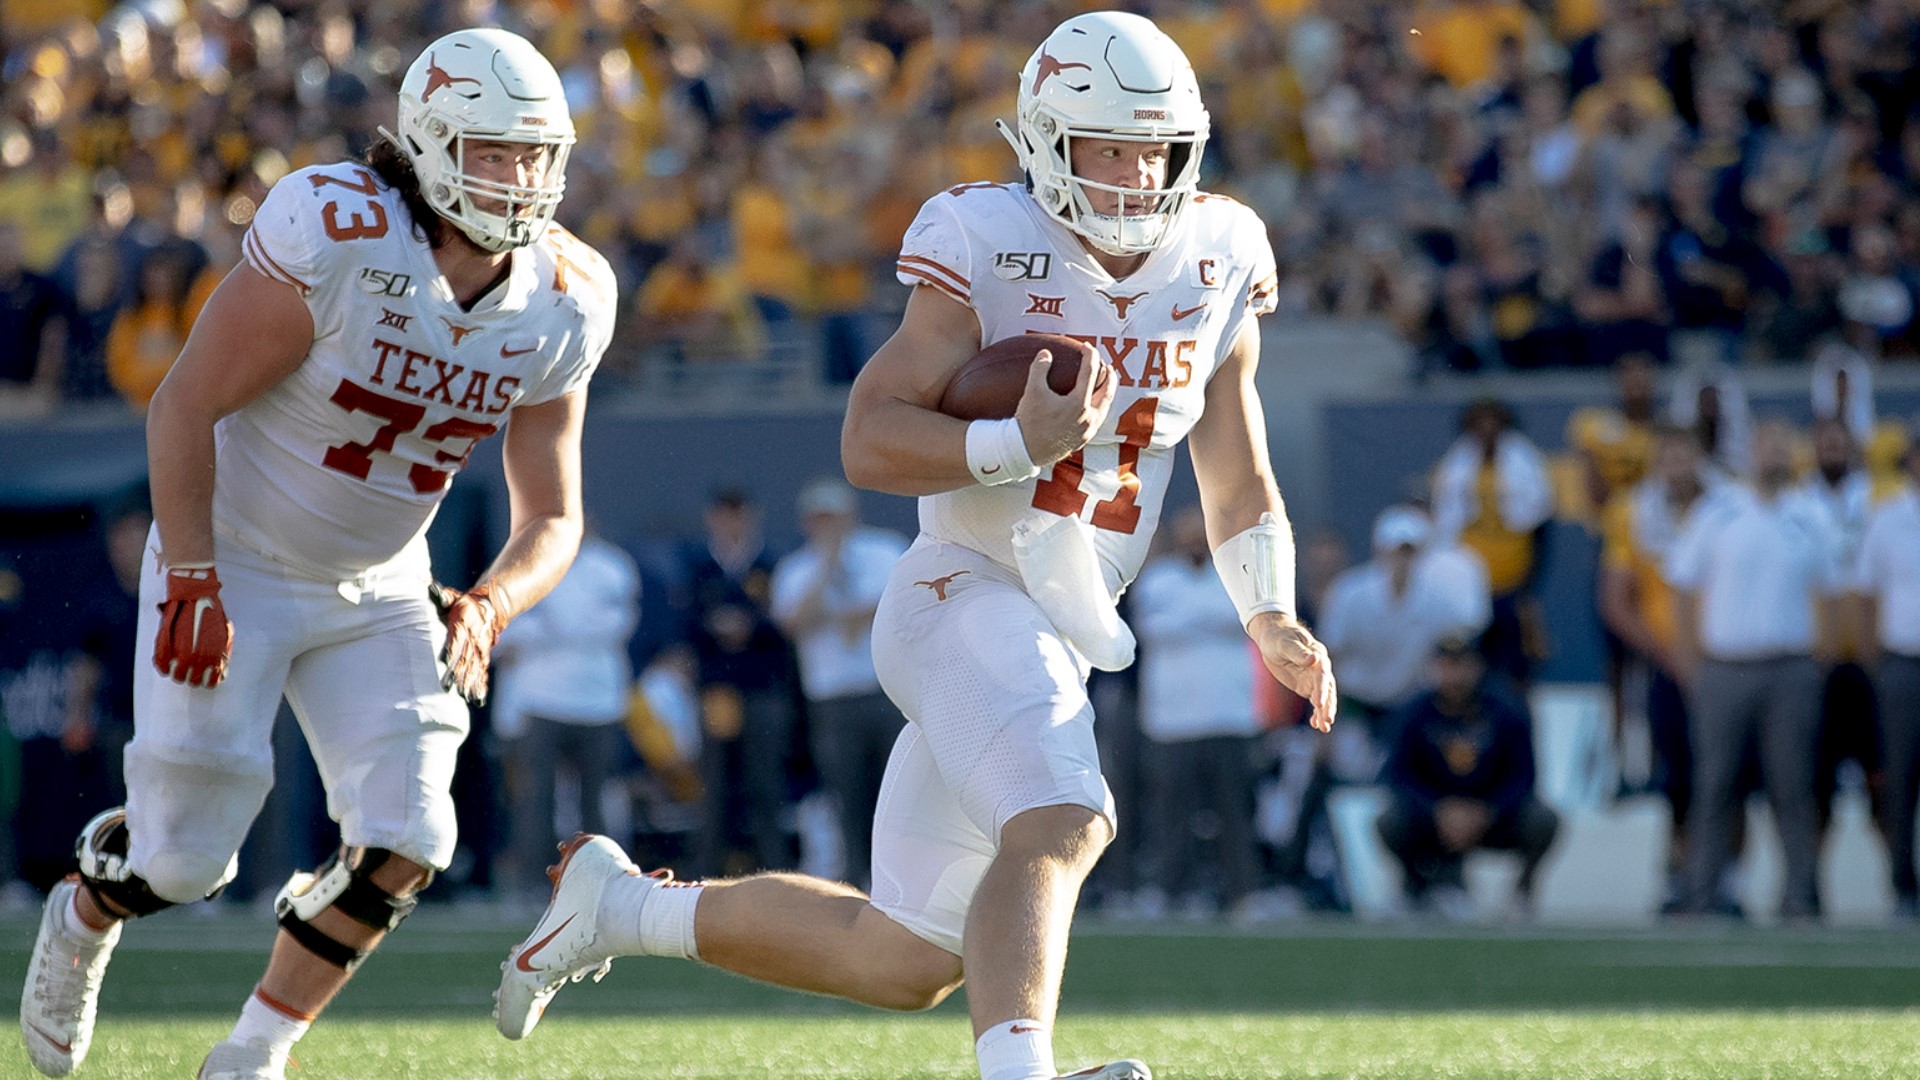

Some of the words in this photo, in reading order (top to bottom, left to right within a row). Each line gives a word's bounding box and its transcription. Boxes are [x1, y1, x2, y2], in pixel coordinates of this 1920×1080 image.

[1133, 109, 1166, 120] HORNS
[307, 169, 388, 242] 73
[361, 267, 410, 298] 150
[995, 253, 1051, 280] 150
[1199, 260, 1215, 285] C
[1025, 293, 1066, 318] XII
[371, 338, 521, 414] TEXAS
[1026, 330, 1196, 388] XAS
[322, 378, 498, 494] 73
[1032, 397, 1158, 534] 11
